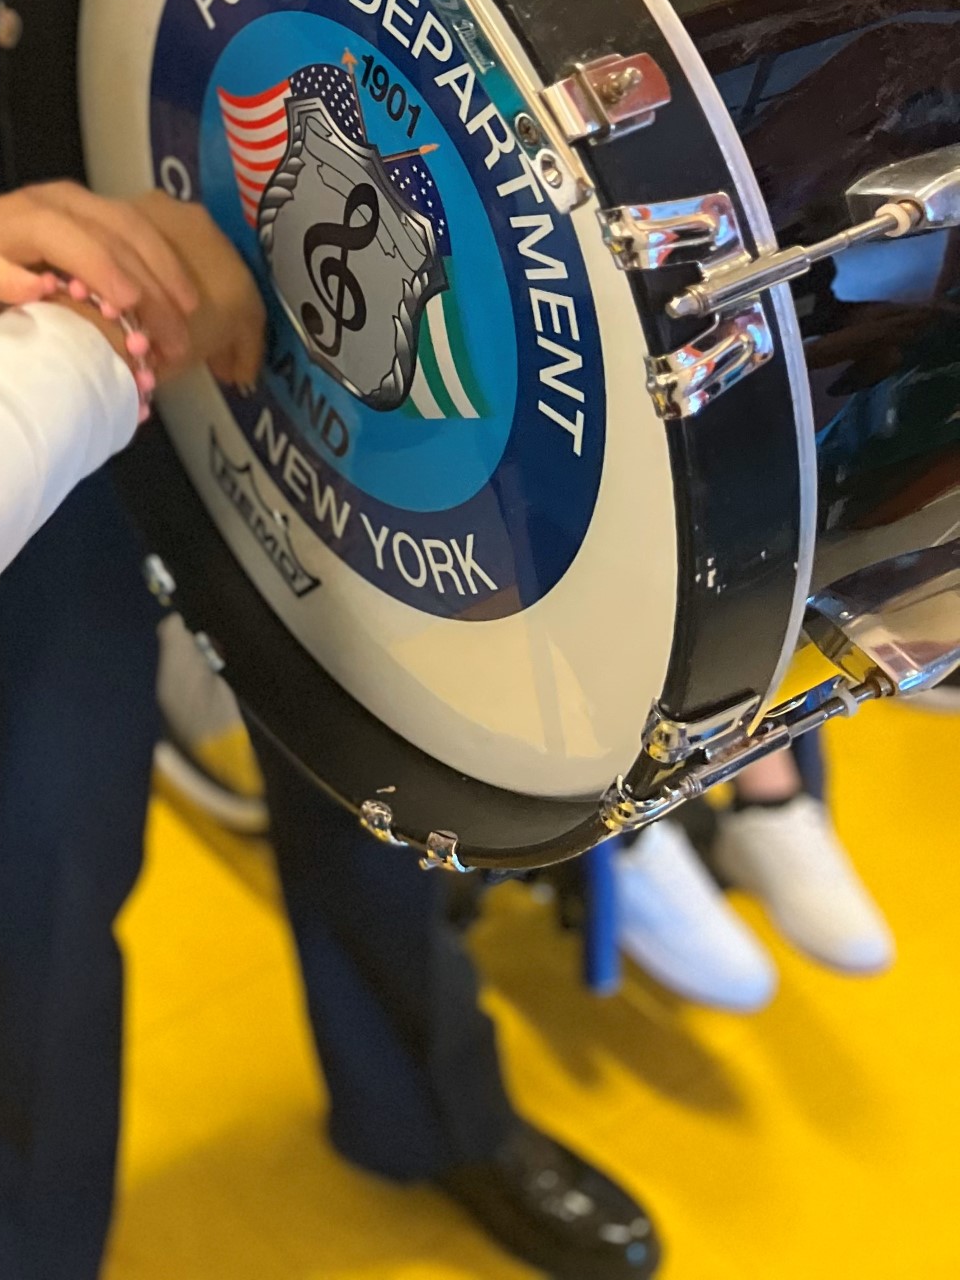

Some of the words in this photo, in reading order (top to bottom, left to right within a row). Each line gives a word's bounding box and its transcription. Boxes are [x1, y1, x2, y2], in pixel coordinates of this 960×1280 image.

[361, 54, 422, 139] 1901
[253, 407, 351, 540] NEW
[359, 511, 499, 595] YORK
